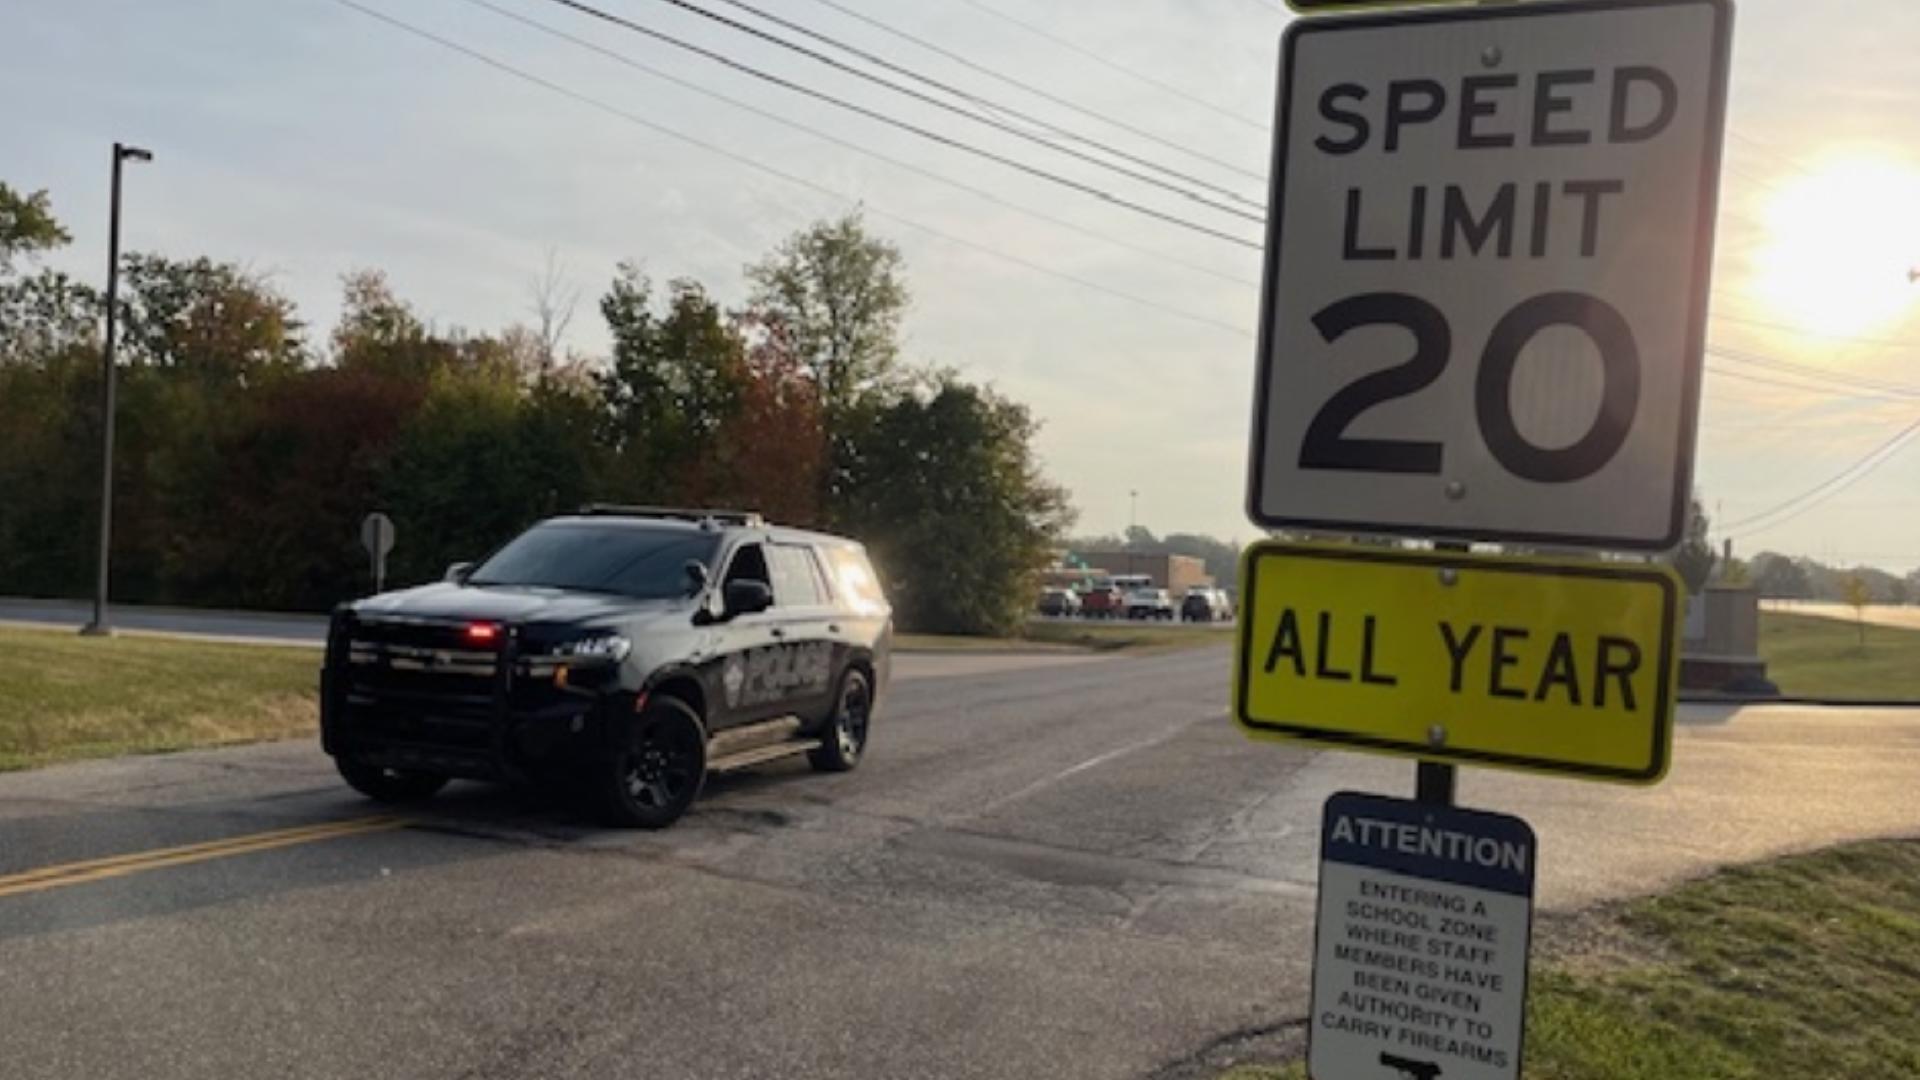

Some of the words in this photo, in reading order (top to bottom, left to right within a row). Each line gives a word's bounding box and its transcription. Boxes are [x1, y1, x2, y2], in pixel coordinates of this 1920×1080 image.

[1314, 66, 1679, 154] SPEED
[1343, 180, 1625, 260] LIMIT
[1298, 291, 1641, 483] 20
[1264, 608, 1397, 686] ALL
[1438, 622, 1642, 711] YEAR
[1331, 815, 1526, 873] ATTENTION
[1347, 901, 1430, 930] SCHOOL
[1440, 917, 1497, 942] ZONE
[1360, 881, 1466, 914] ENTERING
[1471, 901, 1487, 917] A
[1334, 944, 1438, 978] MEMBERS
[1445, 969, 1503, 992] HAVE
[1346, 924, 1424, 950] WHERE
[1427, 937, 1496, 964] STAFF
[1338, 991, 1460, 1029] AUTHORITY
[1465, 1018, 1493, 1040] TO
[1354, 970, 1410, 994] BEEN
[1415, 985, 1481, 1012] GIVEN
[1321, 1012, 1393, 1040] CARRY
[1398, 1028, 1508, 1069] FIREARMS
